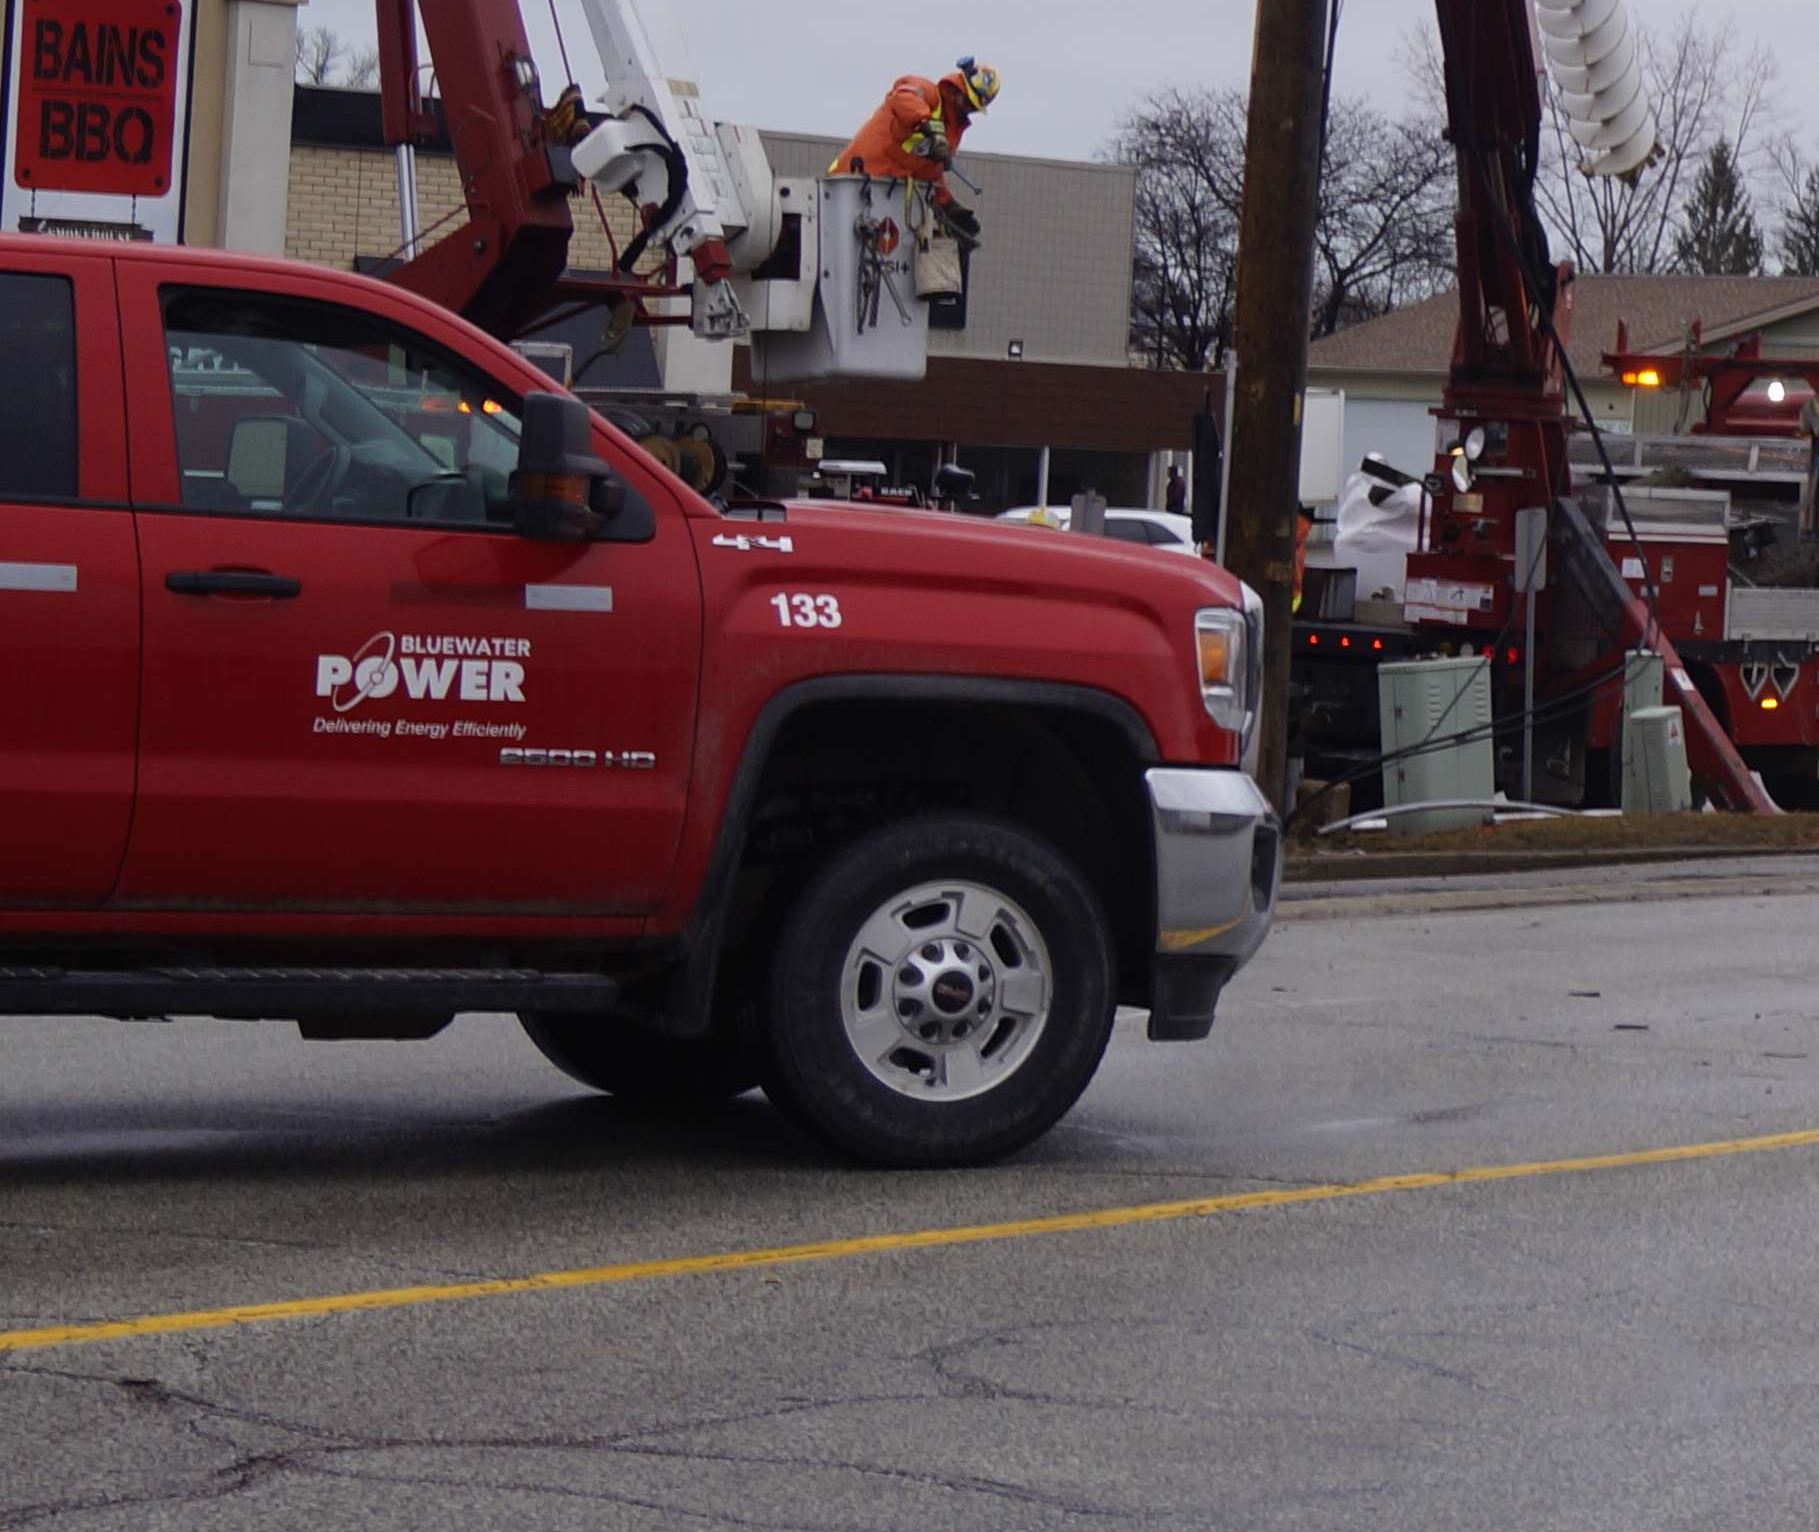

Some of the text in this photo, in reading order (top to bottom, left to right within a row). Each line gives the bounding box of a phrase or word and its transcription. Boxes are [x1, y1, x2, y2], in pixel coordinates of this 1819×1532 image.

[33, 19, 166, 90] BAINS
[39, 99, 154, 165] BBQ
[770, 592, 842, 628] 133
[400, 634, 532, 657] BLUEWATER
[315, 654, 527, 702] POWER
[313, 717, 528, 741] Delivering Energy Efficiently
